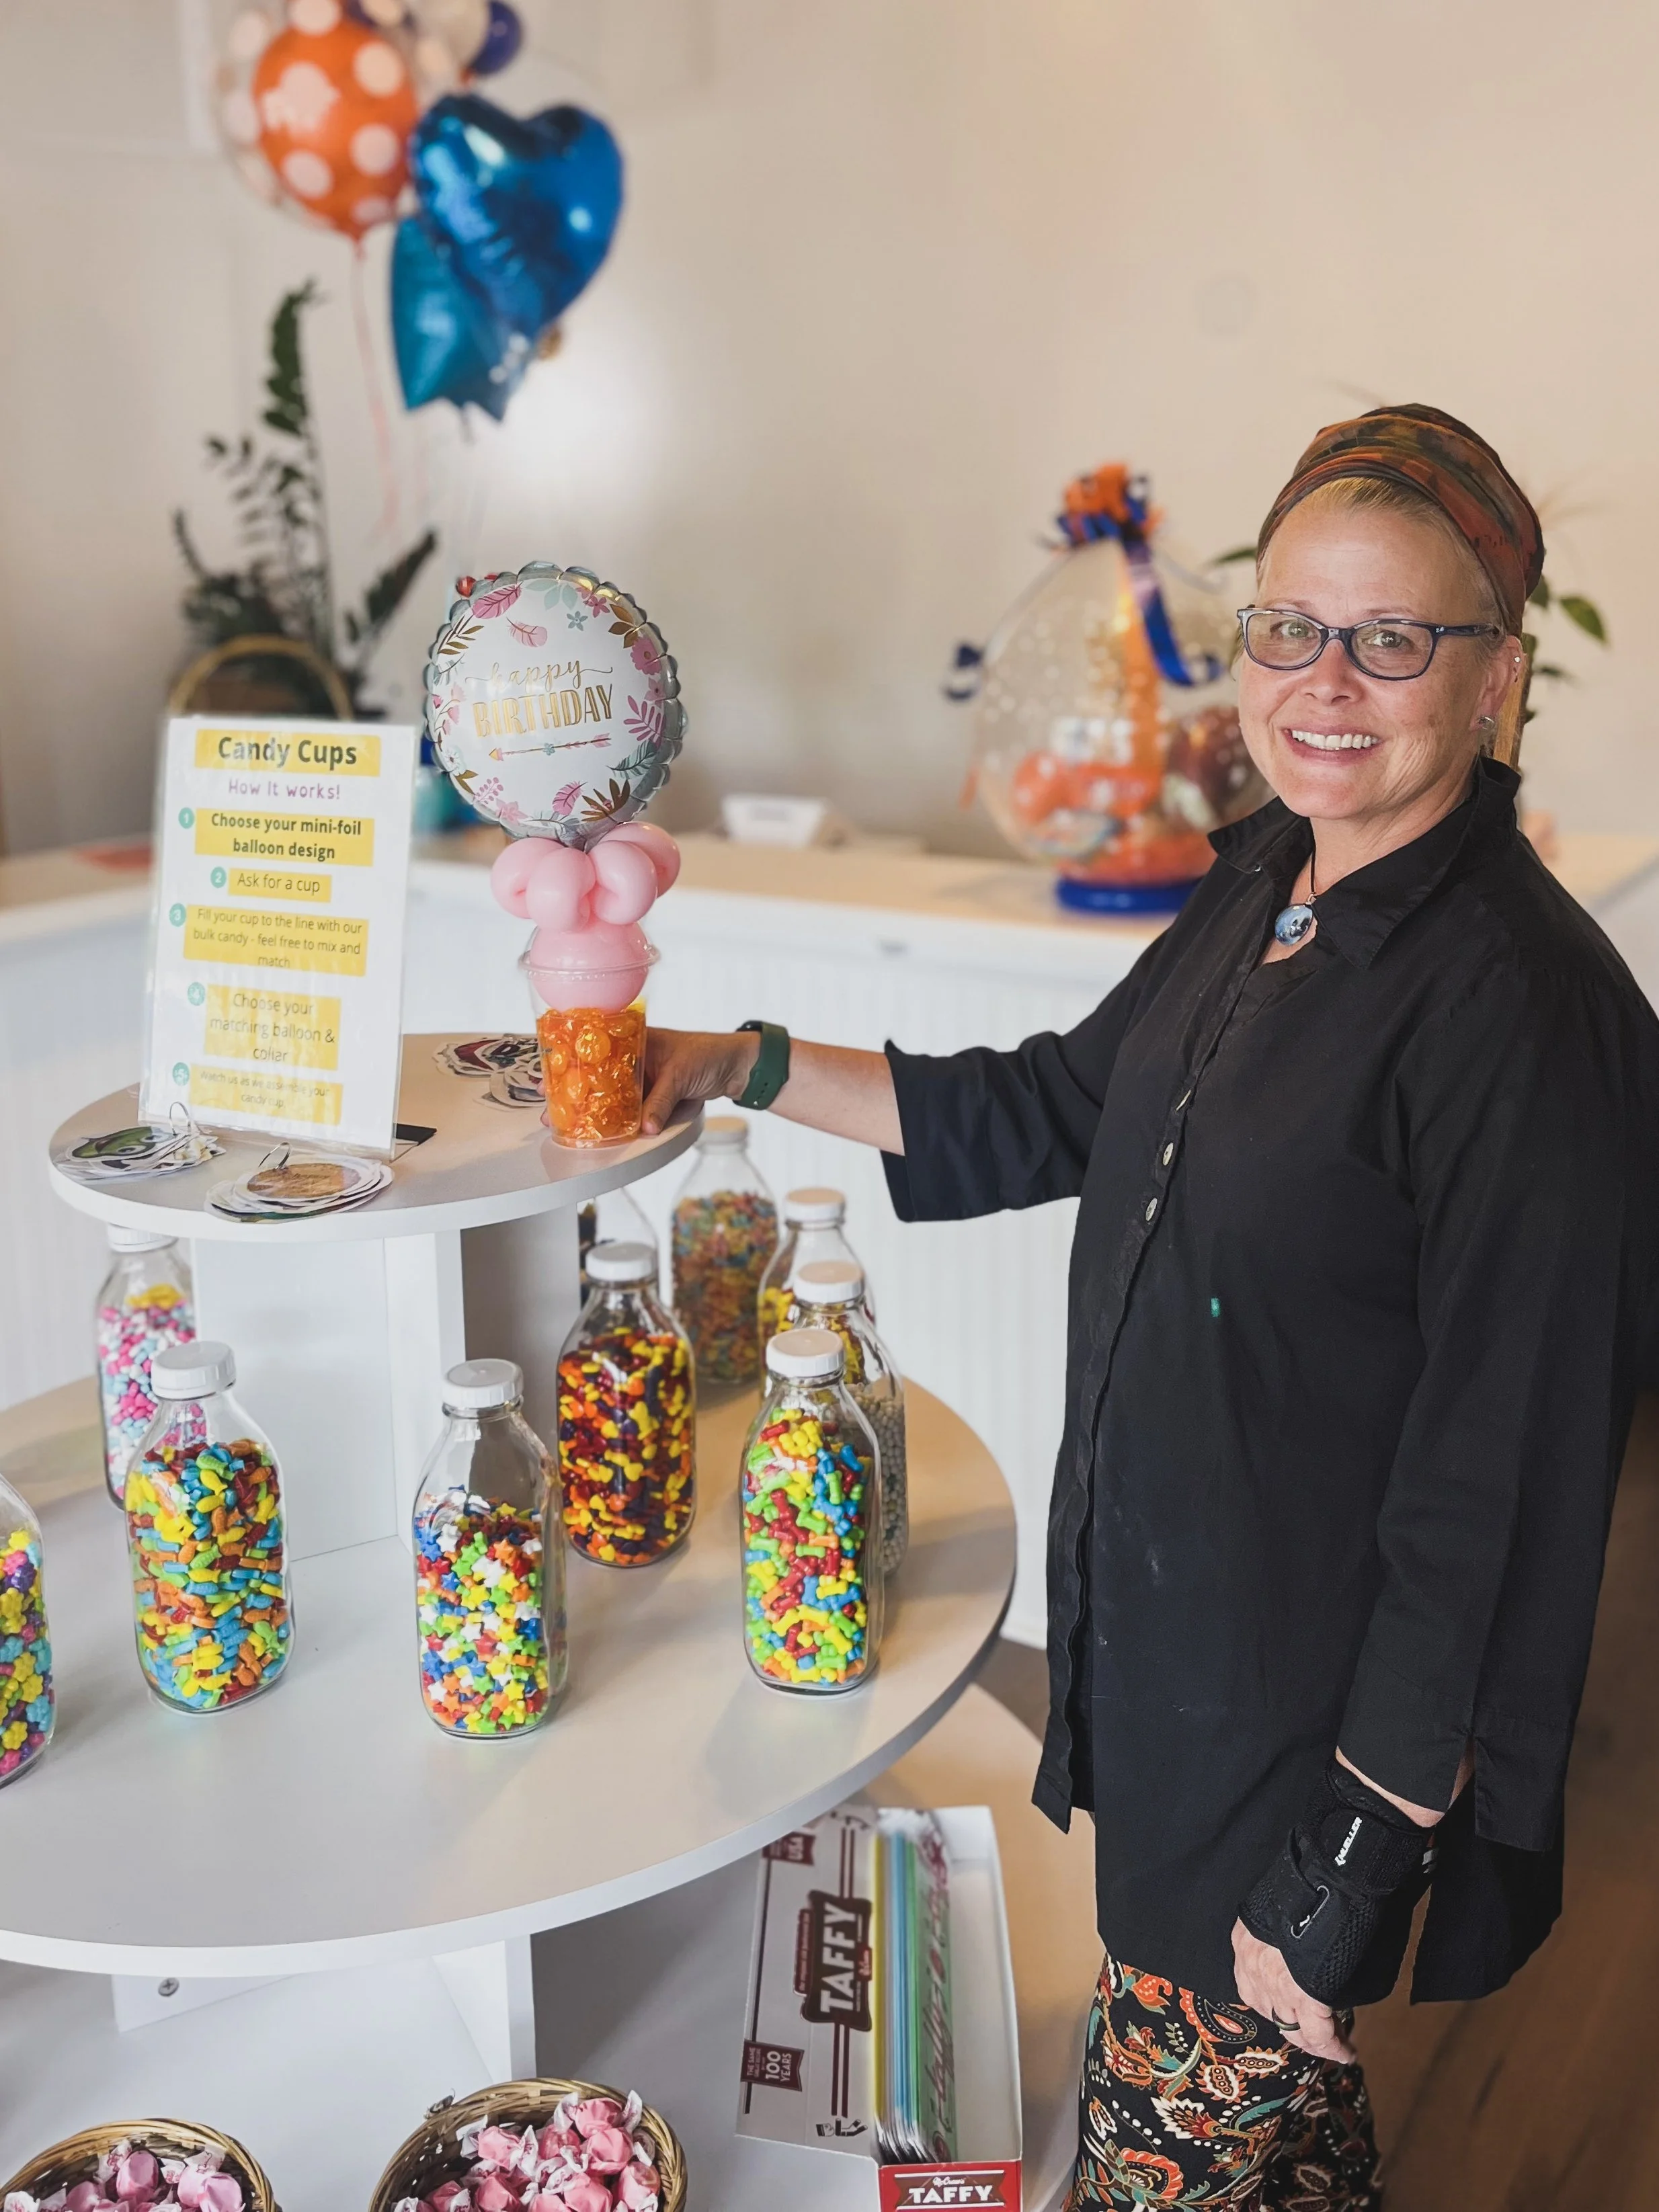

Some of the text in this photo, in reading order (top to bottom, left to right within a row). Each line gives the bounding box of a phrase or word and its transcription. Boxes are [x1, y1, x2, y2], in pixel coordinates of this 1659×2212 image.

[465, 659, 613, 694] happy
[473, 684, 612, 737] BIRTHDAY
[218, 736, 357, 770] Candy Cups
[229, 778, 341, 800] How It works!
[211, 813, 362, 835] Choose your mini-foil
[233, 838, 335, 862] balloon design
[237, 872, 320, 895] Ask for a cup
[197, 908, 362, 934] Fill your cup to the line with our
[193, 929, 214, 940] bulk
[218, 931, 249, 947] candy
[257, 933, 277, 946] feel
[279, 935, 301, 949] free
[303, 938, 315, 950] to
[317, 940, 337, 952] mix
[339, 942, 361, 955] and
[257, 955, 290, 968] match
[233, 993, 314, 1016] Choose your
[210, 1016, 335, 1043] matching balloon &
[820, 1901, 856, 2013] TAFFY
[748, 2047, 756, 2063] SAME
[765, 2051, 781, 2080] 100
[780, 2053, 792, 2082] YEARS
[909, 2185, 993, 2204] TAFFY
